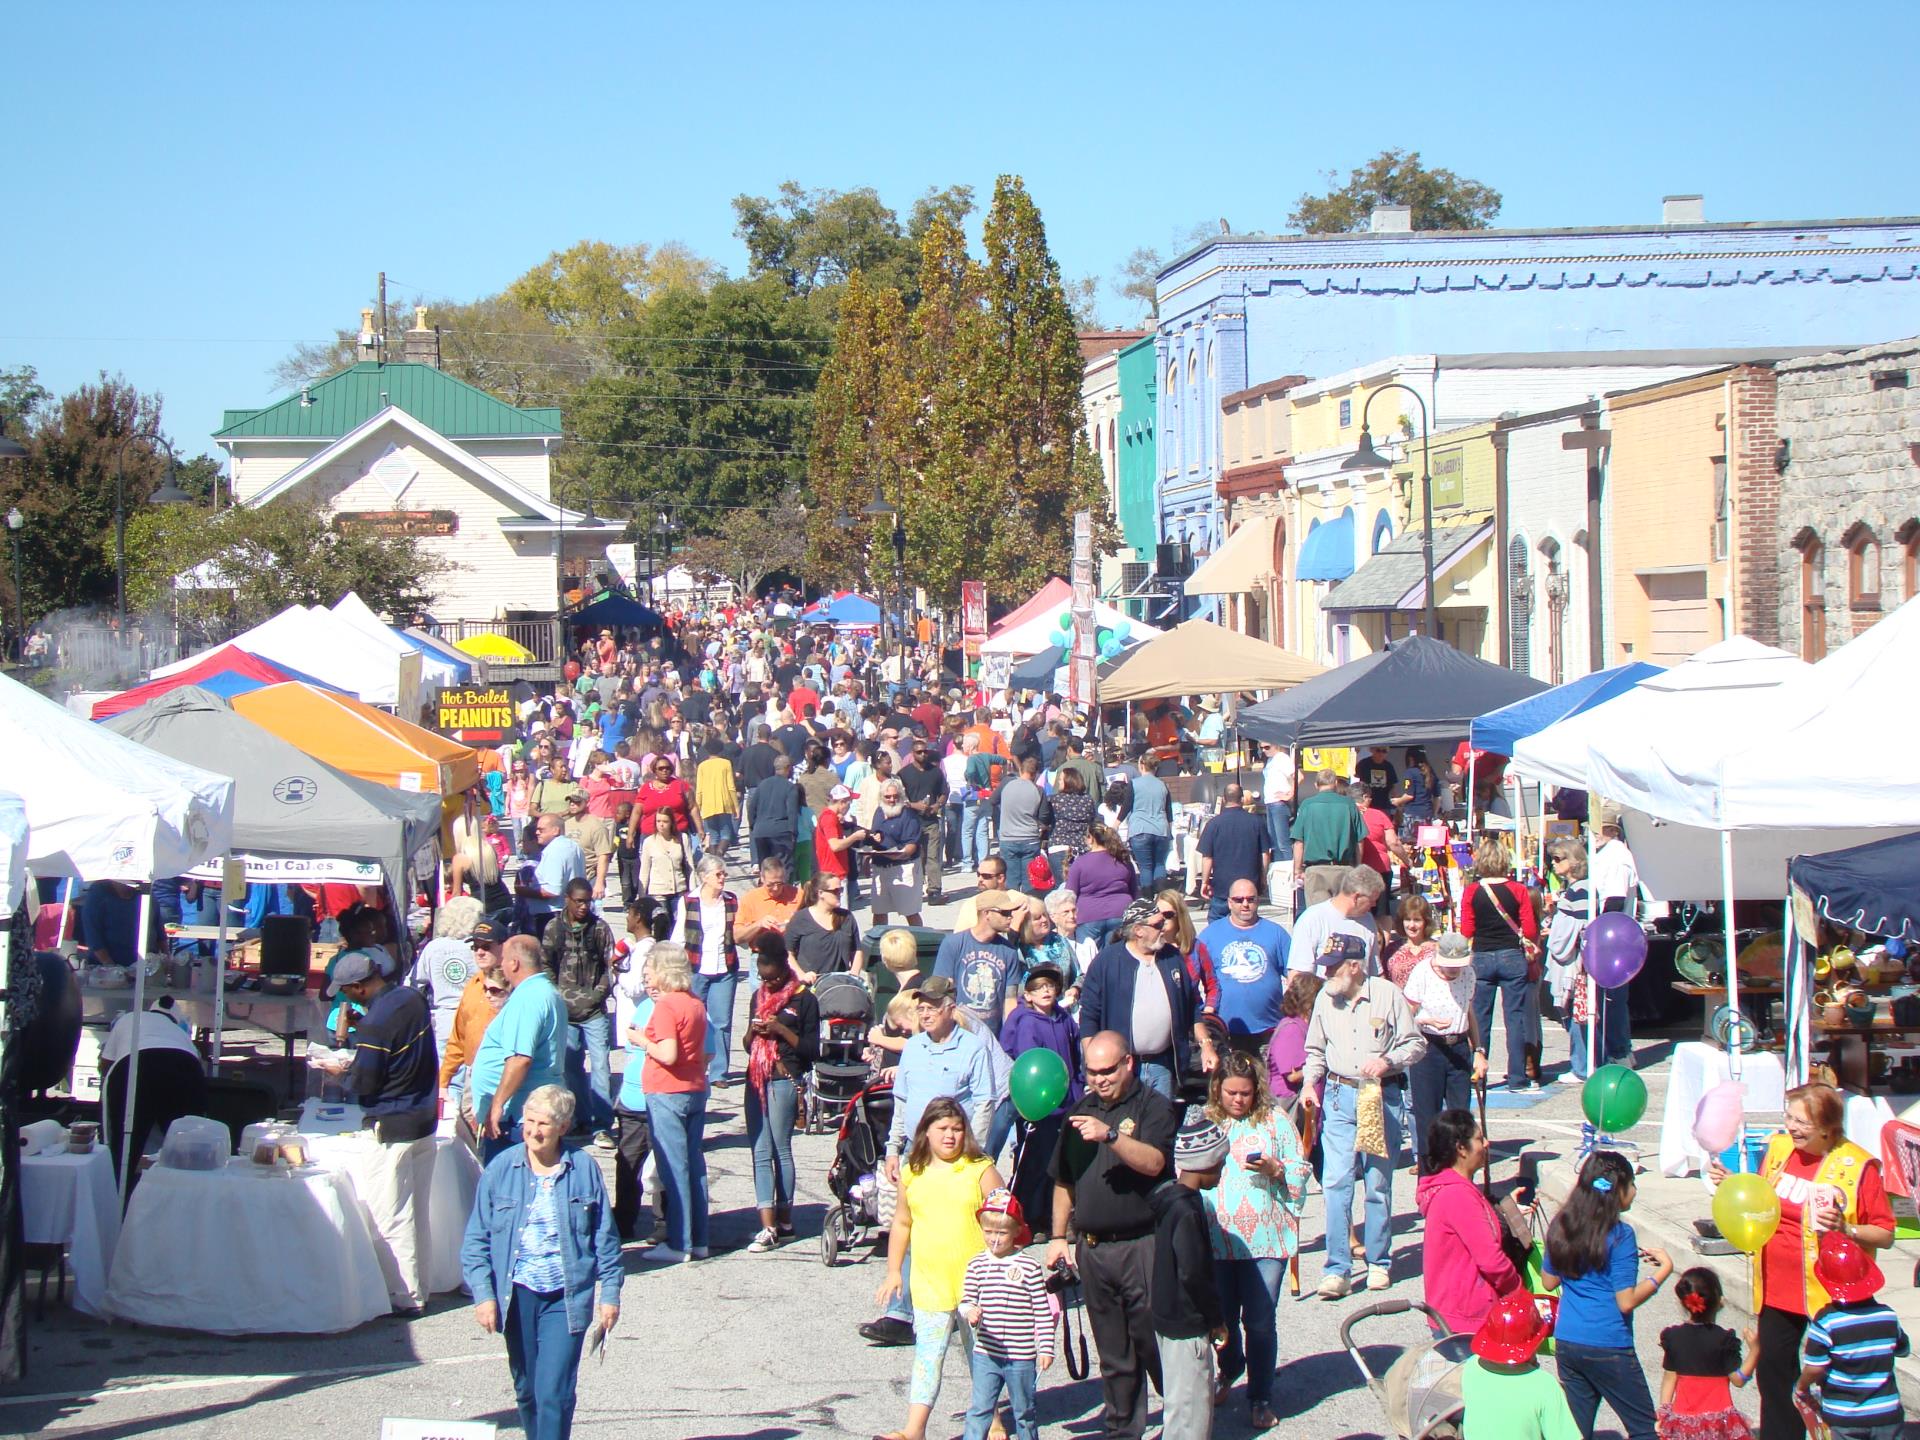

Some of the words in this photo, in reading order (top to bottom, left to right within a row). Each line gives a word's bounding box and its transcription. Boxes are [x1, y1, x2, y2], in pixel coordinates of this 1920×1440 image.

[441, 690, 463, 705] Hot
[464, 688, 510, 705] Boiled
[439, 707, 512, 729] PEANUTS
